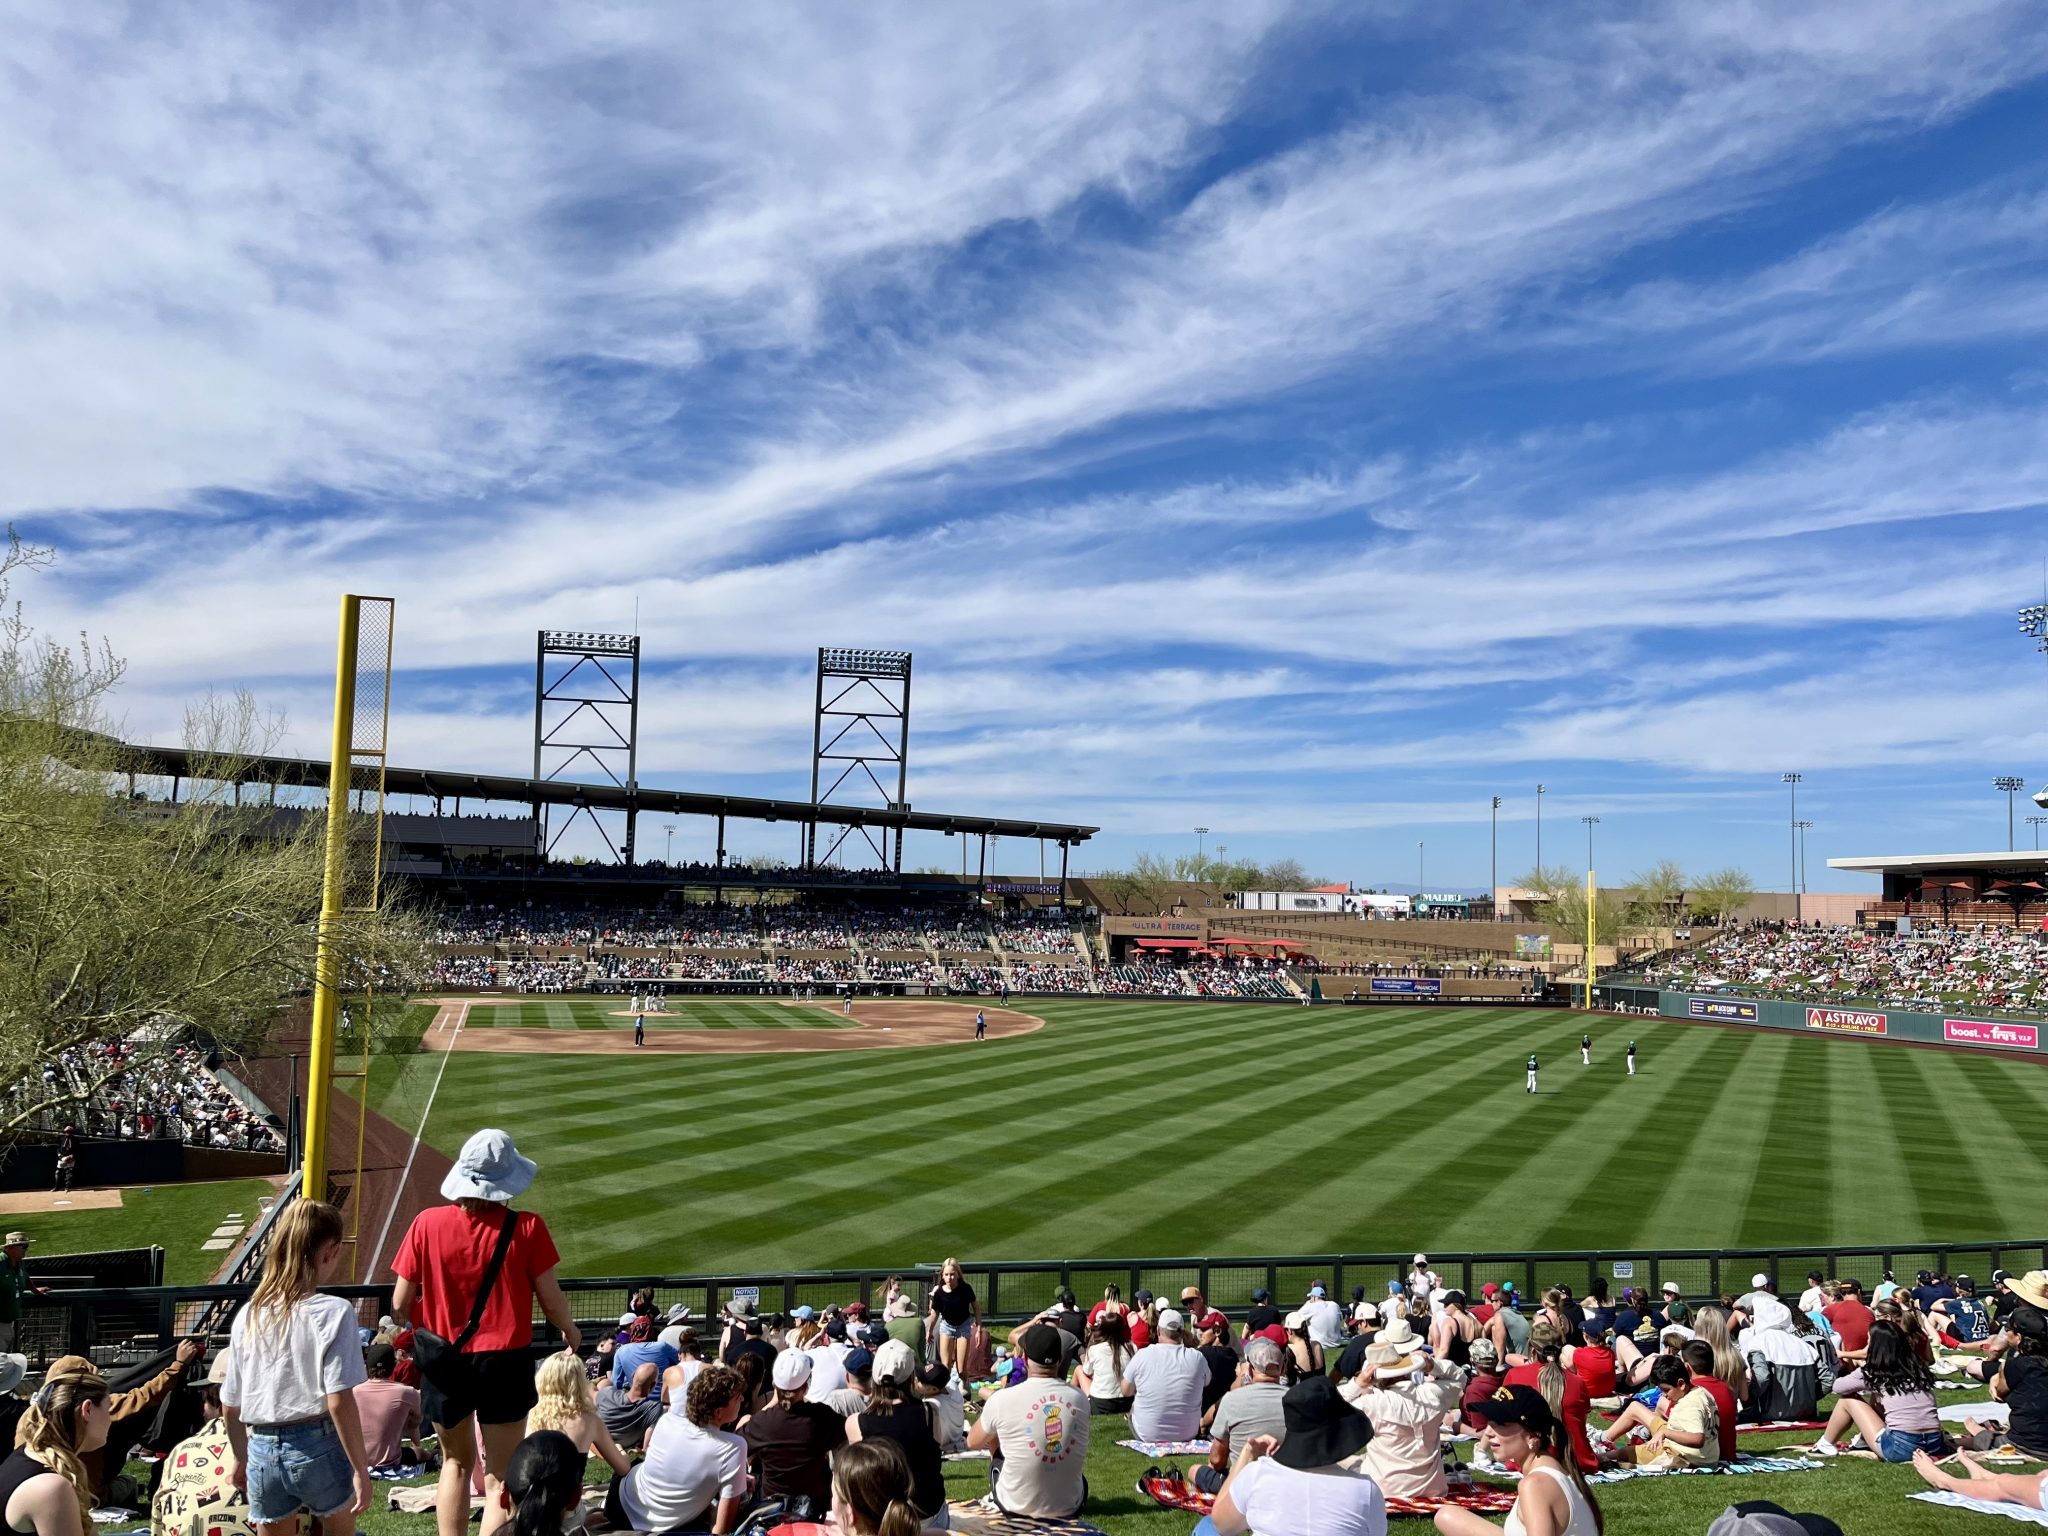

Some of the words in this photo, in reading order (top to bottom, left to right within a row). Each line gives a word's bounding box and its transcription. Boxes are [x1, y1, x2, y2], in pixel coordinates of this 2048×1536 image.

[1423, 894, 1462, 902] MALIBU
[1167, 923, 1201, 931] TERRACE
[1825, 1012, 1879, 1027] ASTRAVO
[1972, 1311, 1990, 1333] A
[1027, 1394, 1077, 1419] DOUBLES
[208, 1513, 237, 1524] ARIZONA
